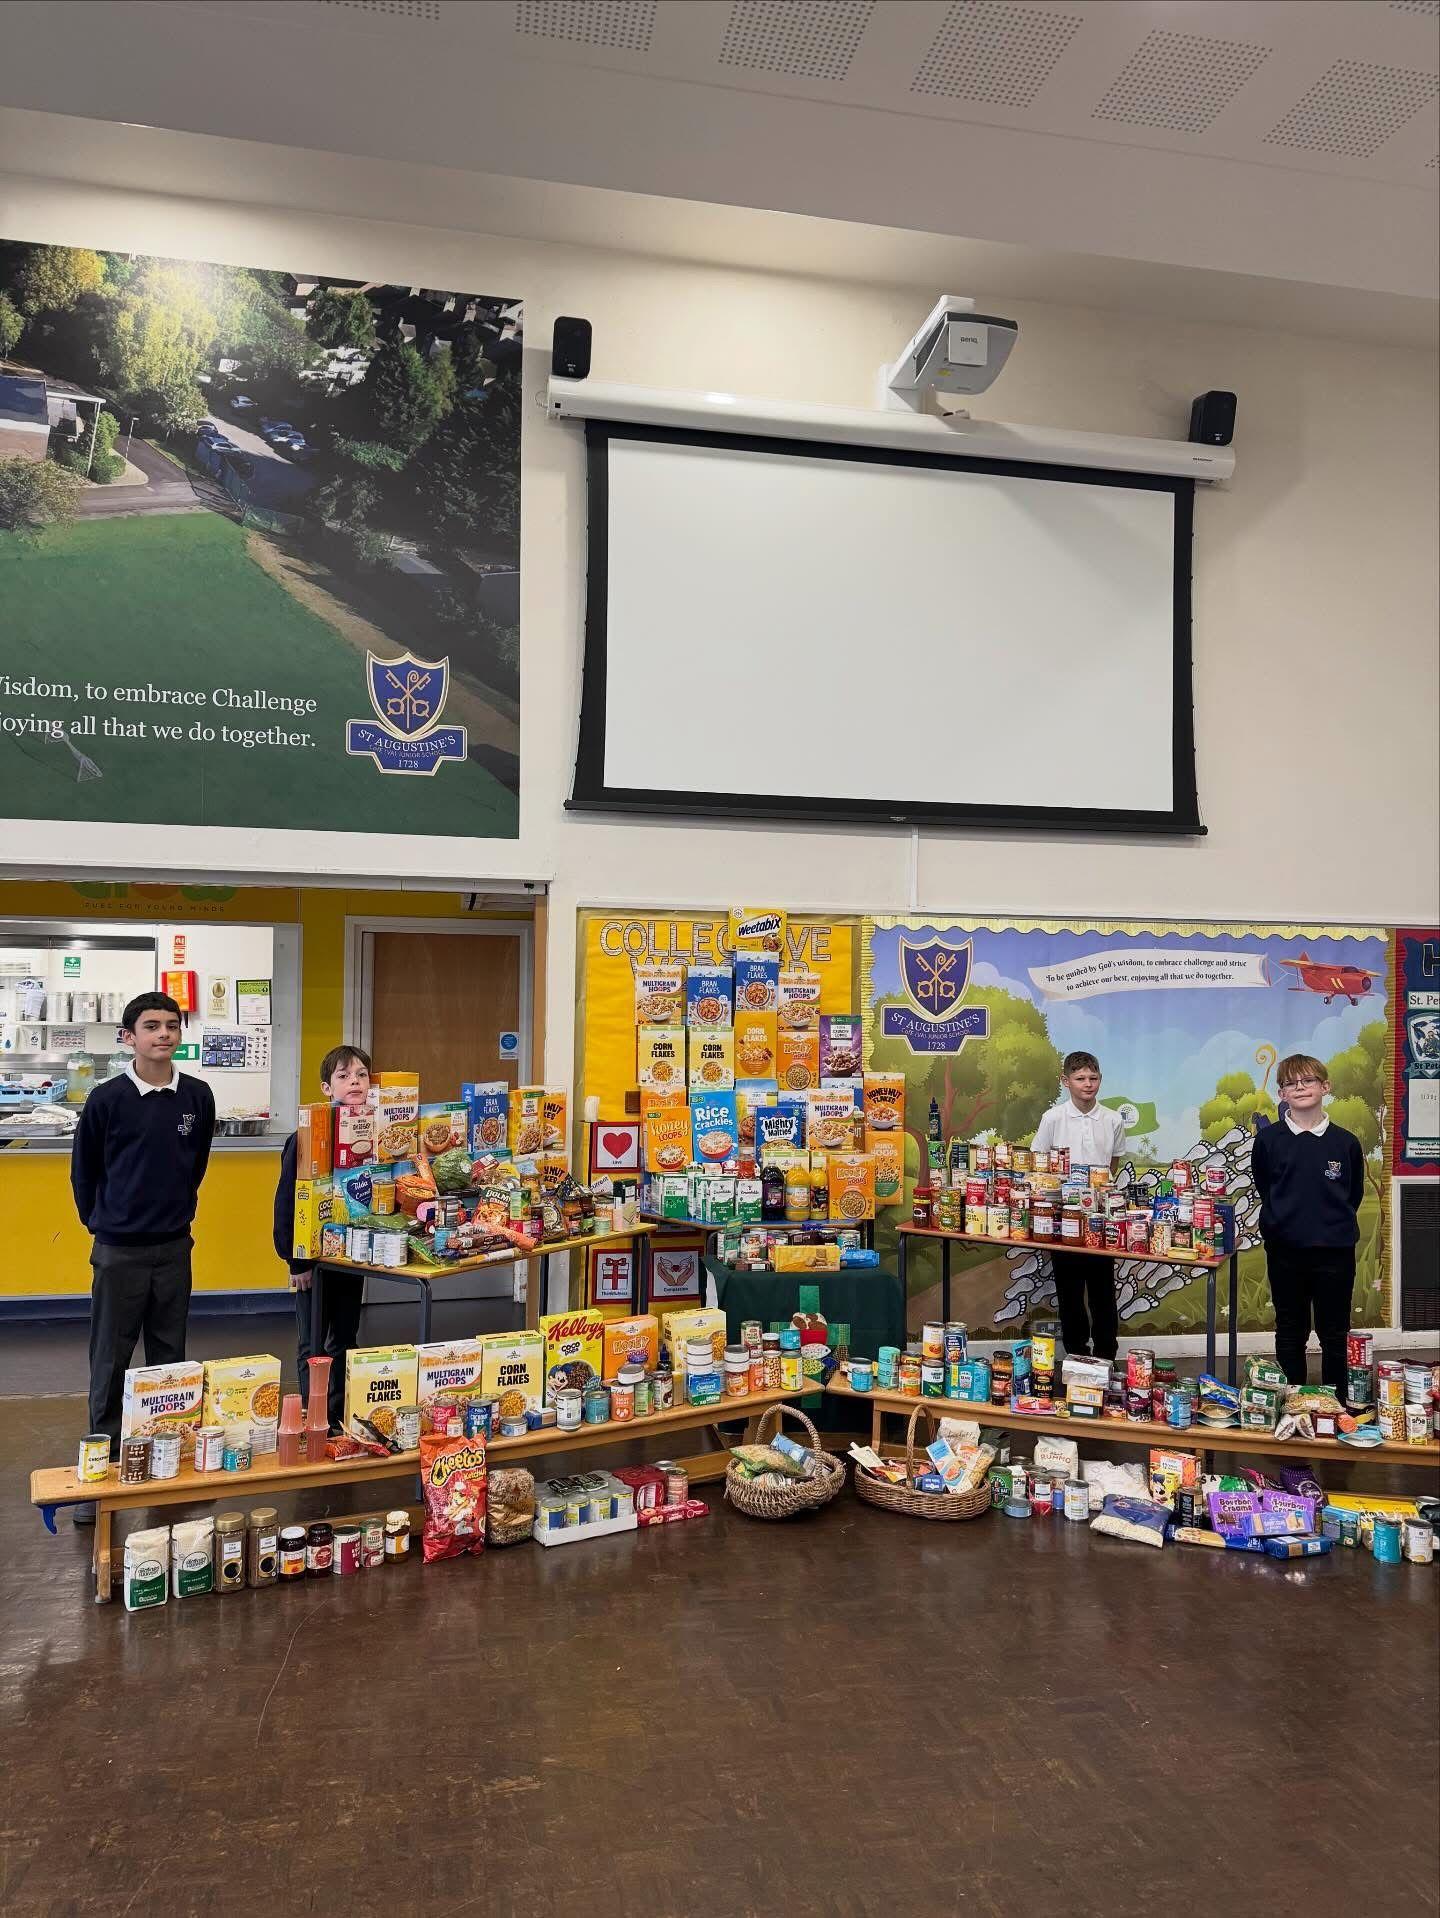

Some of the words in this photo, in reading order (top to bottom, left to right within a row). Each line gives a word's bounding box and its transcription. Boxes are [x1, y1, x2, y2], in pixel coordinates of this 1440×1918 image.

[85, 683, 107, 699] to
[113, 684, 206, 705] embrace
[212, 689, 317, 716] Challenge
[70, 715, 96, 735] all
[102, 717, 147, 738] that
[152, 726, 183, 739] we
[188, 722, 215, 741] do
[221, 726, 316, 748] together.
[358, 730, 374, 742] ST
[376, 735, 456, 752] AUGUSTINE'S
[398, 760, 419, 768] 1728
[738, 917, 782, 936] Weetabix
[600, 921, 831, 961] COLLECVE
[1046, 974, 1055, 982] To
[1056, 973, 1065, 981] be
[1066, 967, 1088, 979] guided
[1089, 965, 1098, 974] by
[1098, 961, 1116, 971] God's
[1117, 959, 1145, 967] wisdom,
[1184, 958, 1215, 967] challenge
[1215, 959, 1228, 967] and
[1075, 979, 1100, 989] achieve
[1131, 975, 1159, 983] enjoying
[1160, 973, 1169, 981] all
[1205, 973, 1235, 981] together.
[891, 1013, 906, 1025] ST
[906, 1013, 980, 1032] AUGUSTINE'S
[949, 1029, 970, 1039] SCHOOL
[653, 1043, 673, 1051] CORN
[703, 1044, 722, 1052] CORN
[928, 1042, 946, 1050] 1728
[867, 1088, 888, 1100] HONEY
[888, 1088, 903, 1099] NUT
[485, 1098, 498, 1106] BRAN
[873, 1096, 897, 1105] FLAKES
[384, 1106, 414, 1116] MULTIGRAIN
[483, 1106, 500, 1114] FLAKES
[695, 1106, 729, 1121] Rice
[389, 1114, 409, 1122] HOOPS
[695, 1117, 733, 1131] Crackles
[651, 1119, 690, 1136] honey
[764, 1119, 794, 1130] Mighty
[659, 1131, 682, 1142] LOOPS
[768, 1129, 791, 1137] Malties
[351, 1181, 368, 1190] Tilda
[486, 1190, 510, 1202] DOLM
[320, 1200, 332, 1210] COC
[548, 1316, 605, 1341] Kellogg
[561, 1342, 580, 1352] COCO
[427, 1367, 474, 1381] MULTIGRAIN
[500, 1363, 527, 1376] CORN
[370, 1379, 399, 1392] CORN
[434, 1376, 466, 1388] HOOPS
[497, 1374, 530, 1387] FLAKES
[141, 1392, 195, 1408] MULTIGRAIN
[366, 1390, 402, 1403] FLAKES
[150, 1401, 186, 1415] HOOPS
[431, 1447, 485, 1487] Cheetos
[1220, 1498, 1252, 1506] Bourbon
[1272, 1498, 1306, 1510] Bourbon
